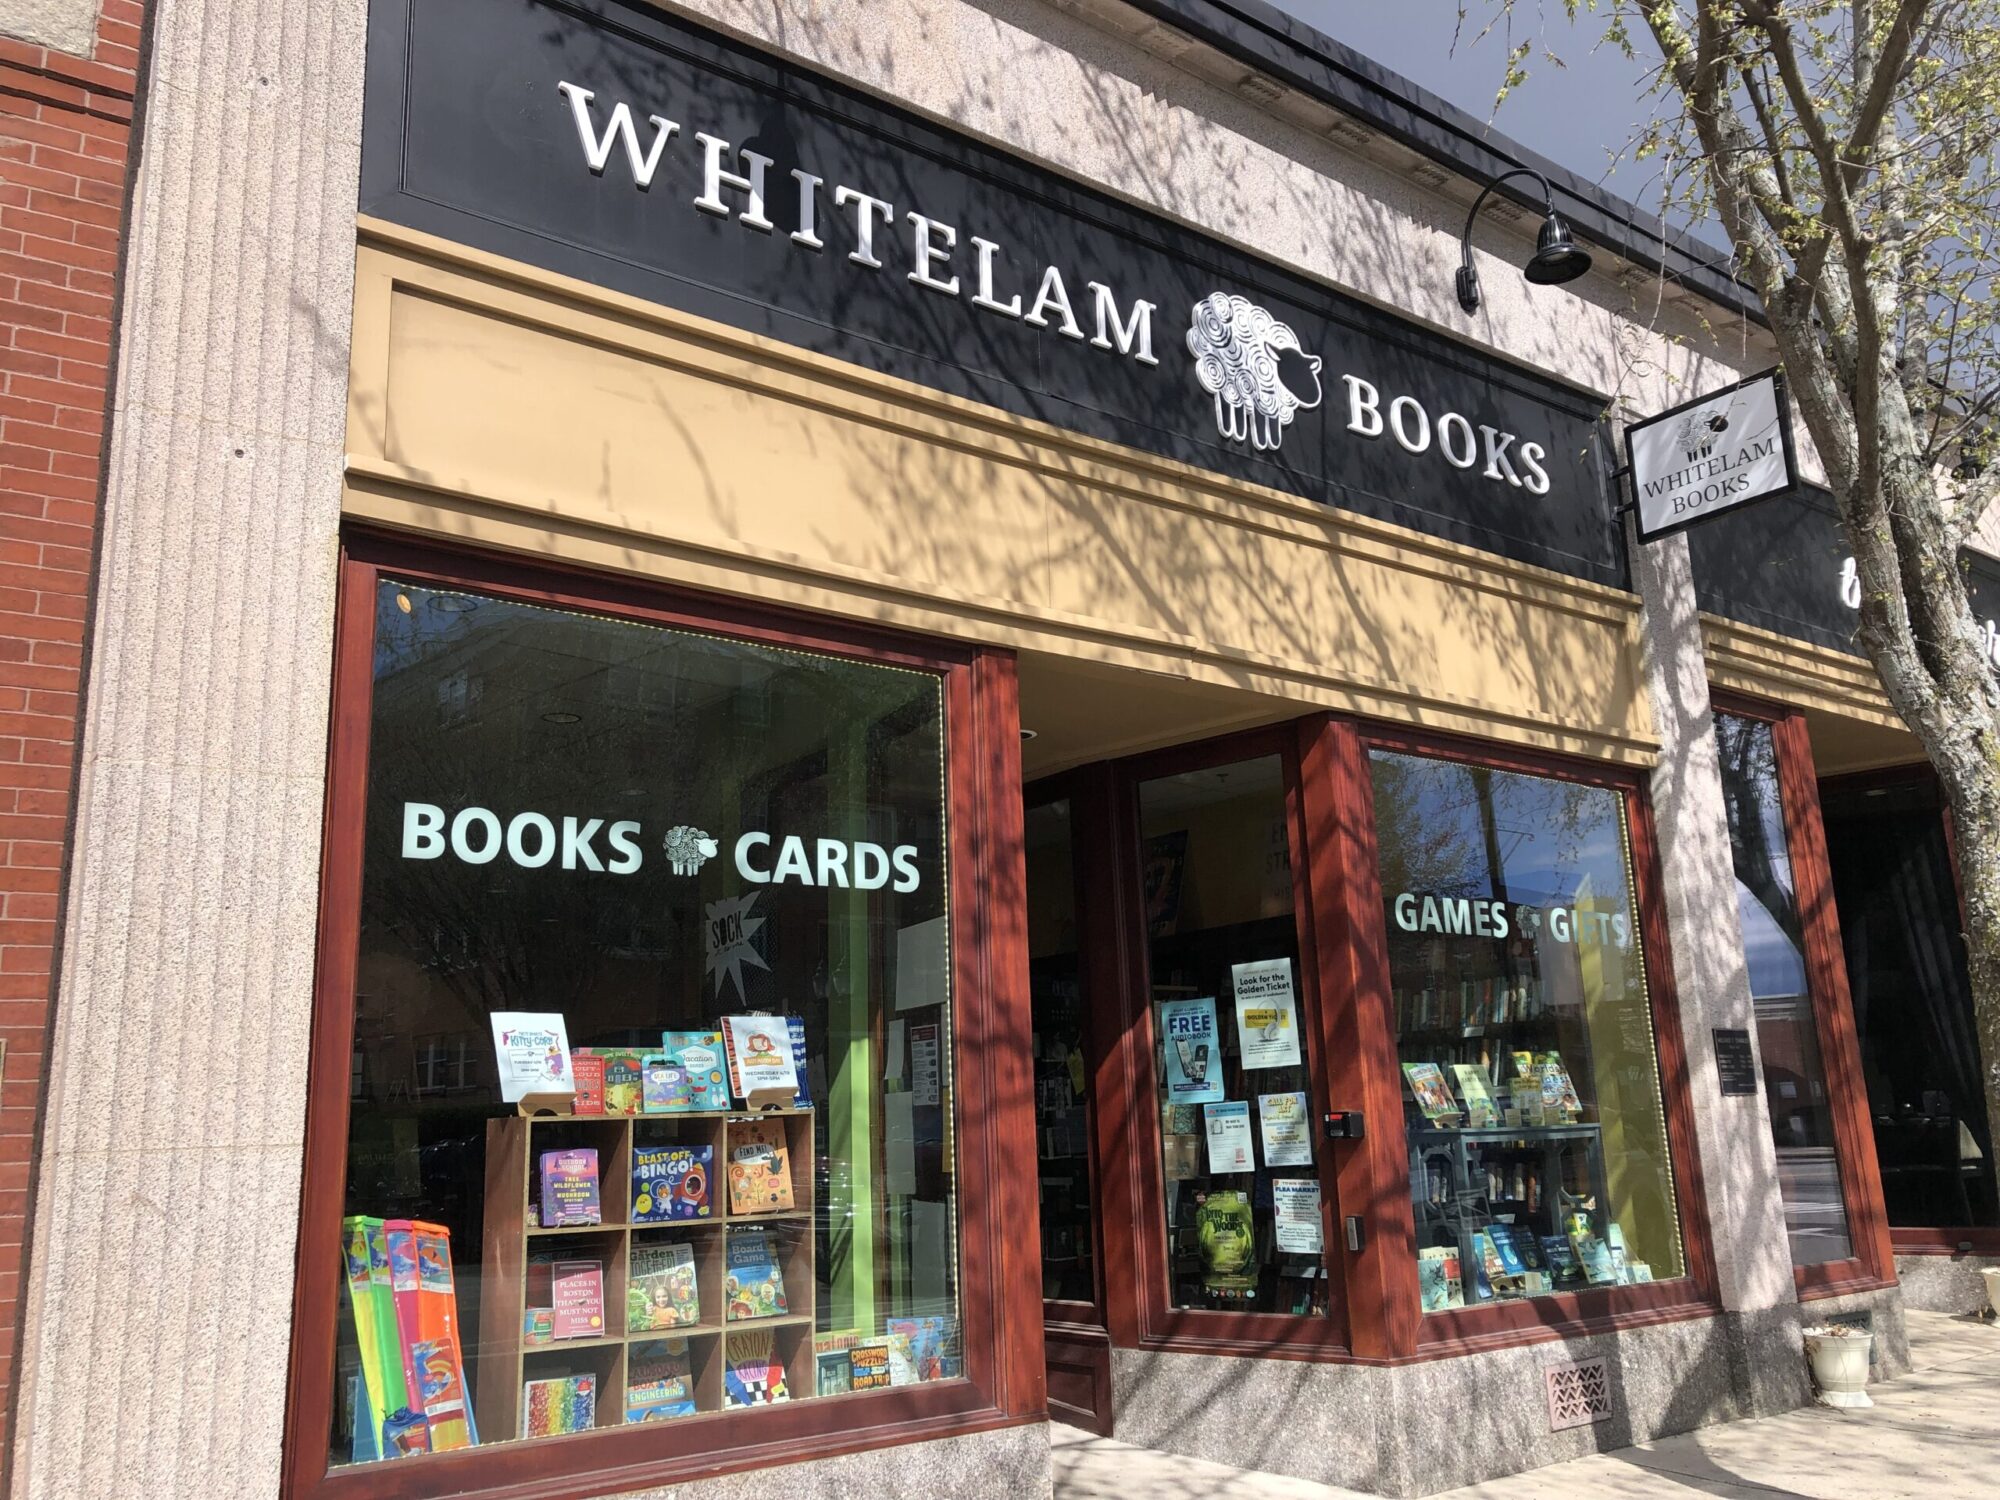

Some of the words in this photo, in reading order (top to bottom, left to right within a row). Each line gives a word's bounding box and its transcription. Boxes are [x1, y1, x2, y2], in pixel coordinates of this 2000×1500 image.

[558, 80, 1160, 366] WHITELAM
[1342, 374, 1551, 495] BOOKS
[1643, 436, 1777, 499] WHITELAM
[1672, 472, 1751, 515] BOOKS
[401, 801, 644, 875] BOOKS
[734, 830, 921, 893] CARDS
[1394, 892, 1510, 939] GAMES
[1549, 907, 1629, 949] GIFTS
[711, 910, 744, 950] SOCK
[1239, 977, 1258, 986] Look
[1259, 975, 1271, 984] for
[1272, 973, 1286, 981] the
[1237, 985, 1265, 995] Golden
[1266, 982, 1291, 991] Ticket
[1168, 1014, 1212, 1035] FREE
[1170, 1030, 1212, 1041] AUDIOBOOK
[739, 1145, 755, 1157] FIND
[756, 1143, 768, 1154] ME!
[641, 1158, 693, 1179] BINGO!
[1225, 1212, 1239, 1222] THE
[629, 1249, 675, 1261] Garden
[732, 1243, 764, 1255] Board
[733, 1254, 766, 1264] Game
[560, 1281, 588, 1289] PLACES
[557, 1299, 576, 1307] THA
[560, 1308, 581, 1316] MUST
[570, 1317, 589, 1325] MISS
[726, 1331, 770, 1362] CRAYON
[851, 1347, 888, 1363] CROSSWORD
[854, 1376, 873, 1388] ROAD
[629, 1386, 685, 1403] ENGINEERING
